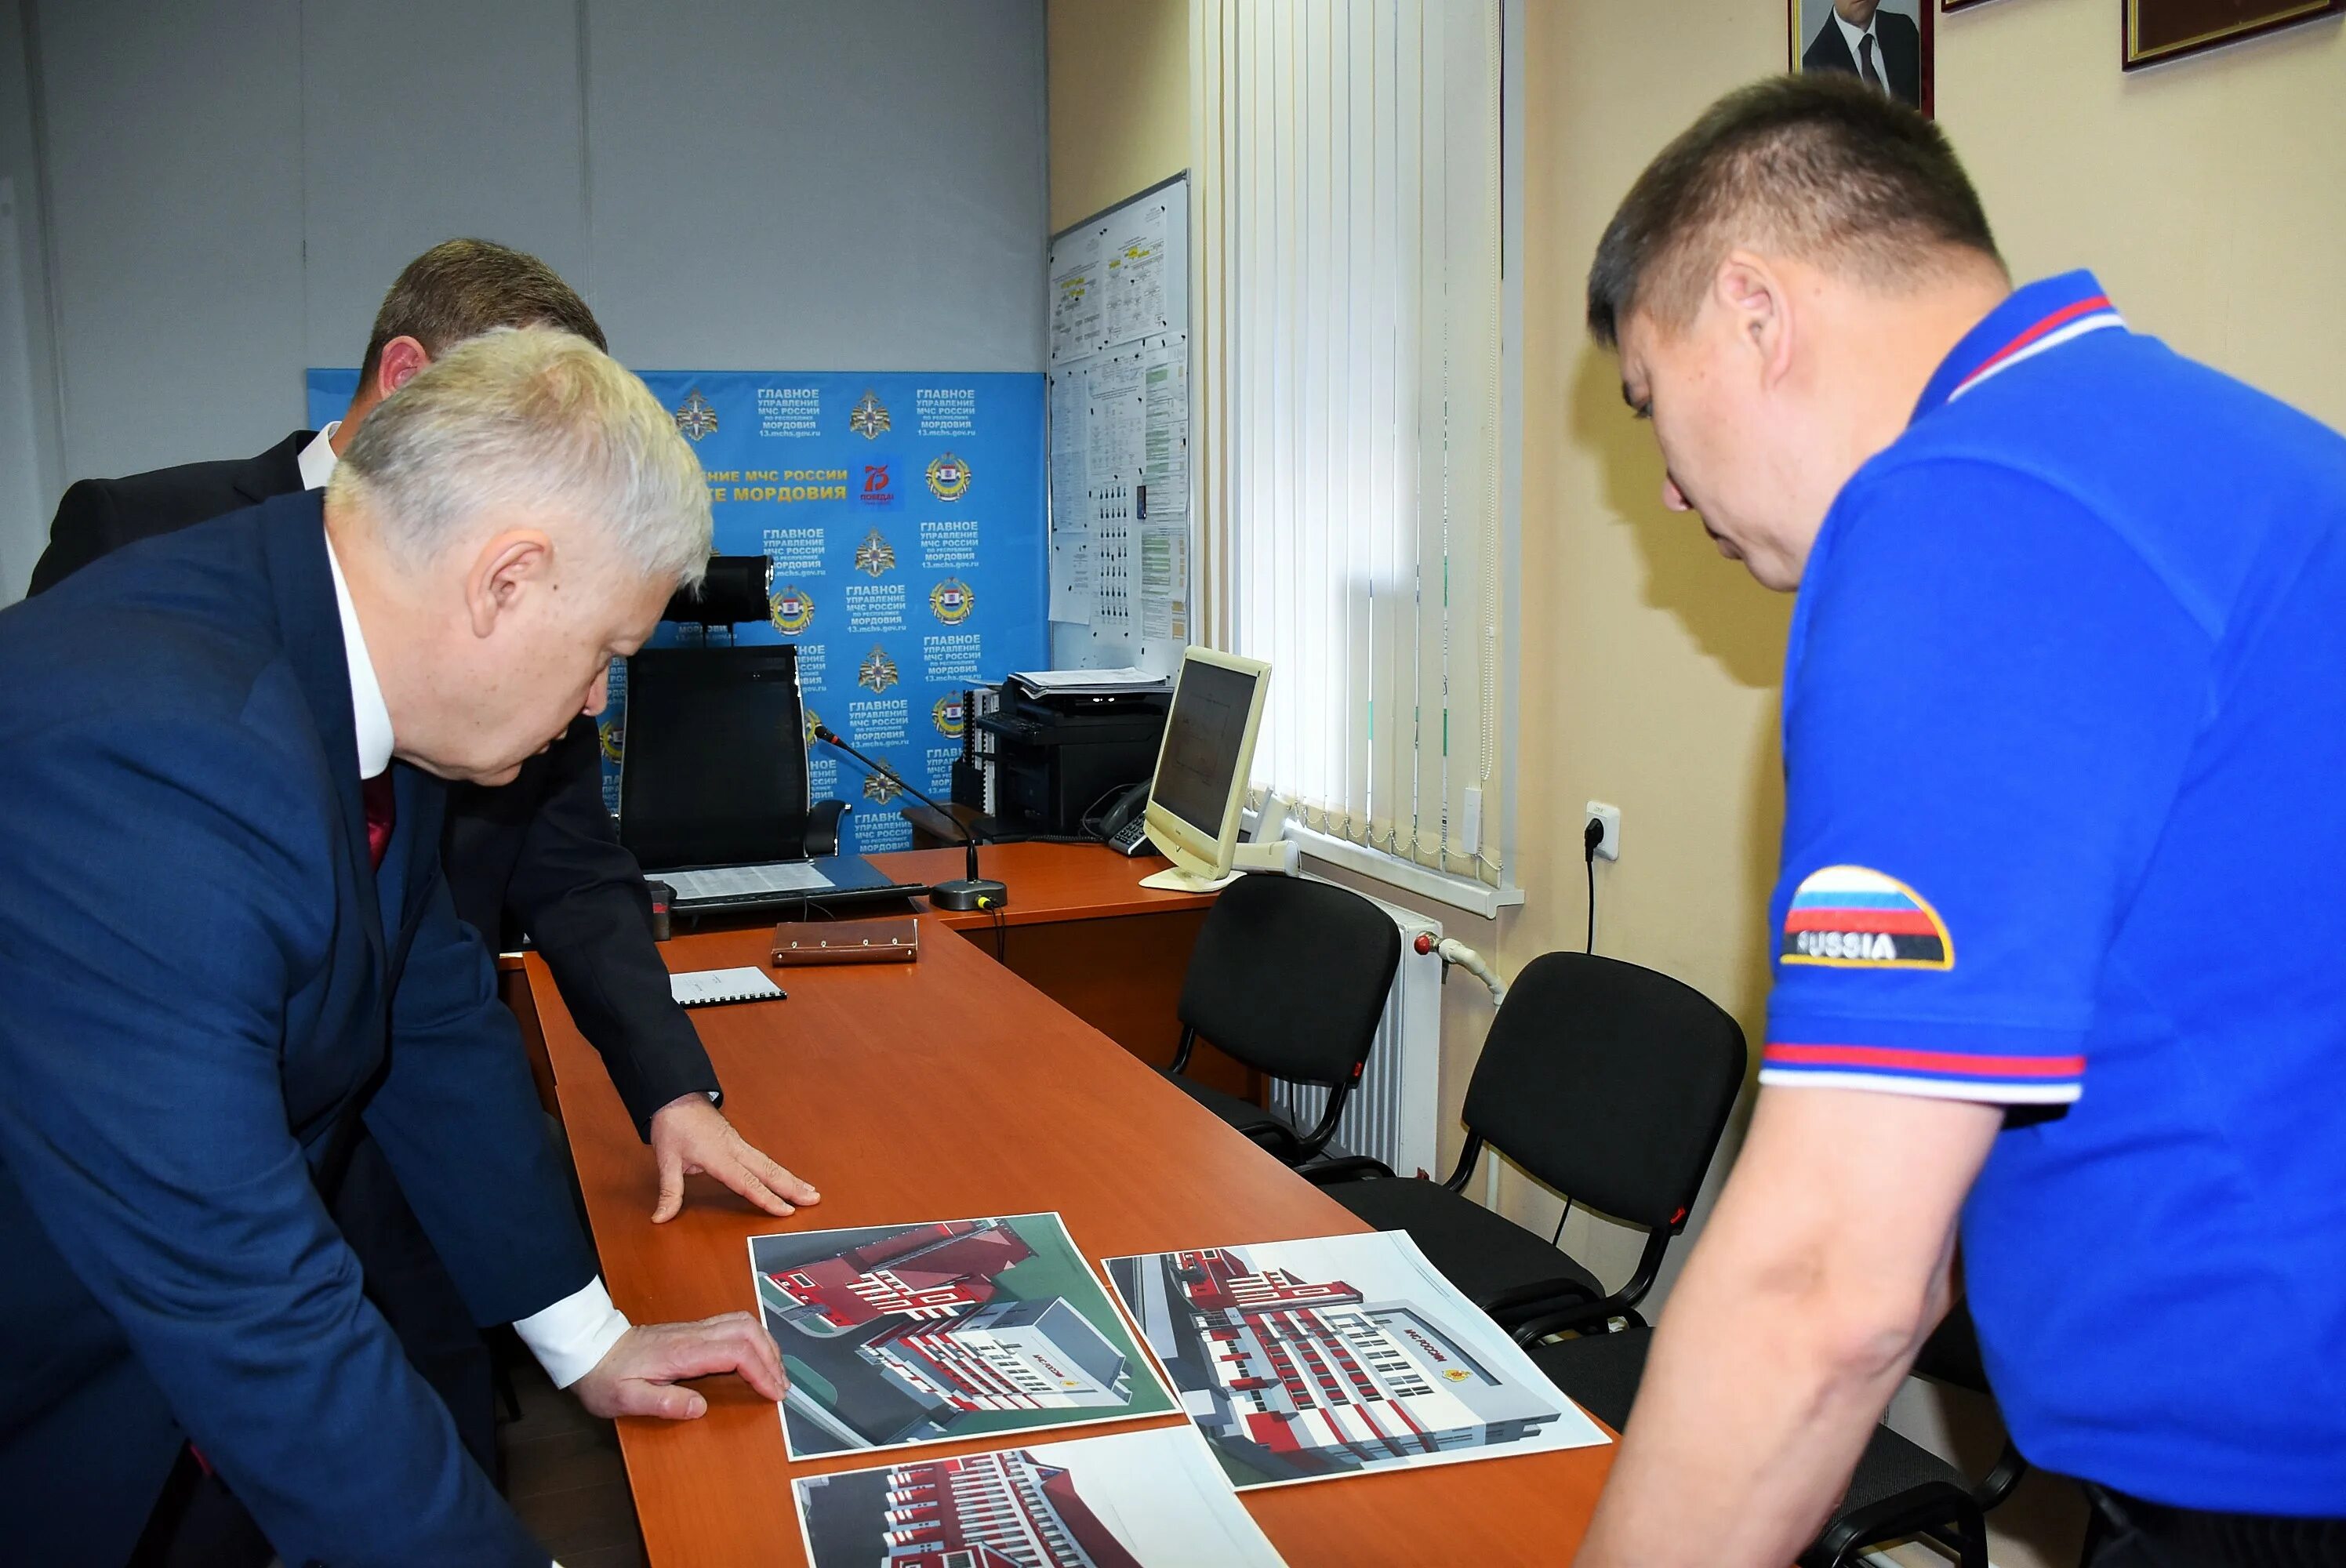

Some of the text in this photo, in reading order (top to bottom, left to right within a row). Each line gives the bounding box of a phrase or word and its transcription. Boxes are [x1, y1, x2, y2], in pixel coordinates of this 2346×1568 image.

[757, 389, 819, 399] ГЛАВНОЕ
[916, 389, 975, 399] ГЛАВНОЕ
[762, 421, 816, 430] МОРДОВИЯ
[746, 470, 779, 482] МЧС
[784, 470, 848, 481] РОССИИ
[734, 486, 847, 502] МОРДОВИЯ
[920, 521, 978, 532] ГЛАВНОЕ
[763, 528, 824, 539] ГЛАВНОЕ
[763, 539, 824, 547] УПРАВЛЕНИЕ
[786, 546, 825, 555] РОССИИ
[925, 553, 975, 561] МОРДОВИЯ
[846, 585, 906, 596] ГЛАВНОЕ
[846, 595, 906, 604] УПРАВЛЕНИЕ
[869, 602, 906, 611] РОССИИ
[851, 616, 902, 626] МОРДОВИЯ
[924, 634, 981, 645] ГЛАВНОЕ
[924, 644, 981, 654] УПРАВЛЕНИЕ
[945, 652, 982, 660] РОССИИ
[928, 665, 978, 674] МОРДОВИЯ
[849, 699, 908, 712] ГЛАВНОЕ
[849, 710, 908, 719] УПРАВЛЕНИЕ
[872, 717, 908, 726] РОССИИ
[854, 731, 905, 740] МОРДОВИЯ
[927, 747, 963, 758] ГЛАВН
[855, 811, 903, 824] ГЛАВНО
[855, 821, 913, 831] УПРАВЛЕНИЕ
[877, 829, 913, 837] РОССИИ
[859, 842, 910, 852] МОРДОВИЯ
